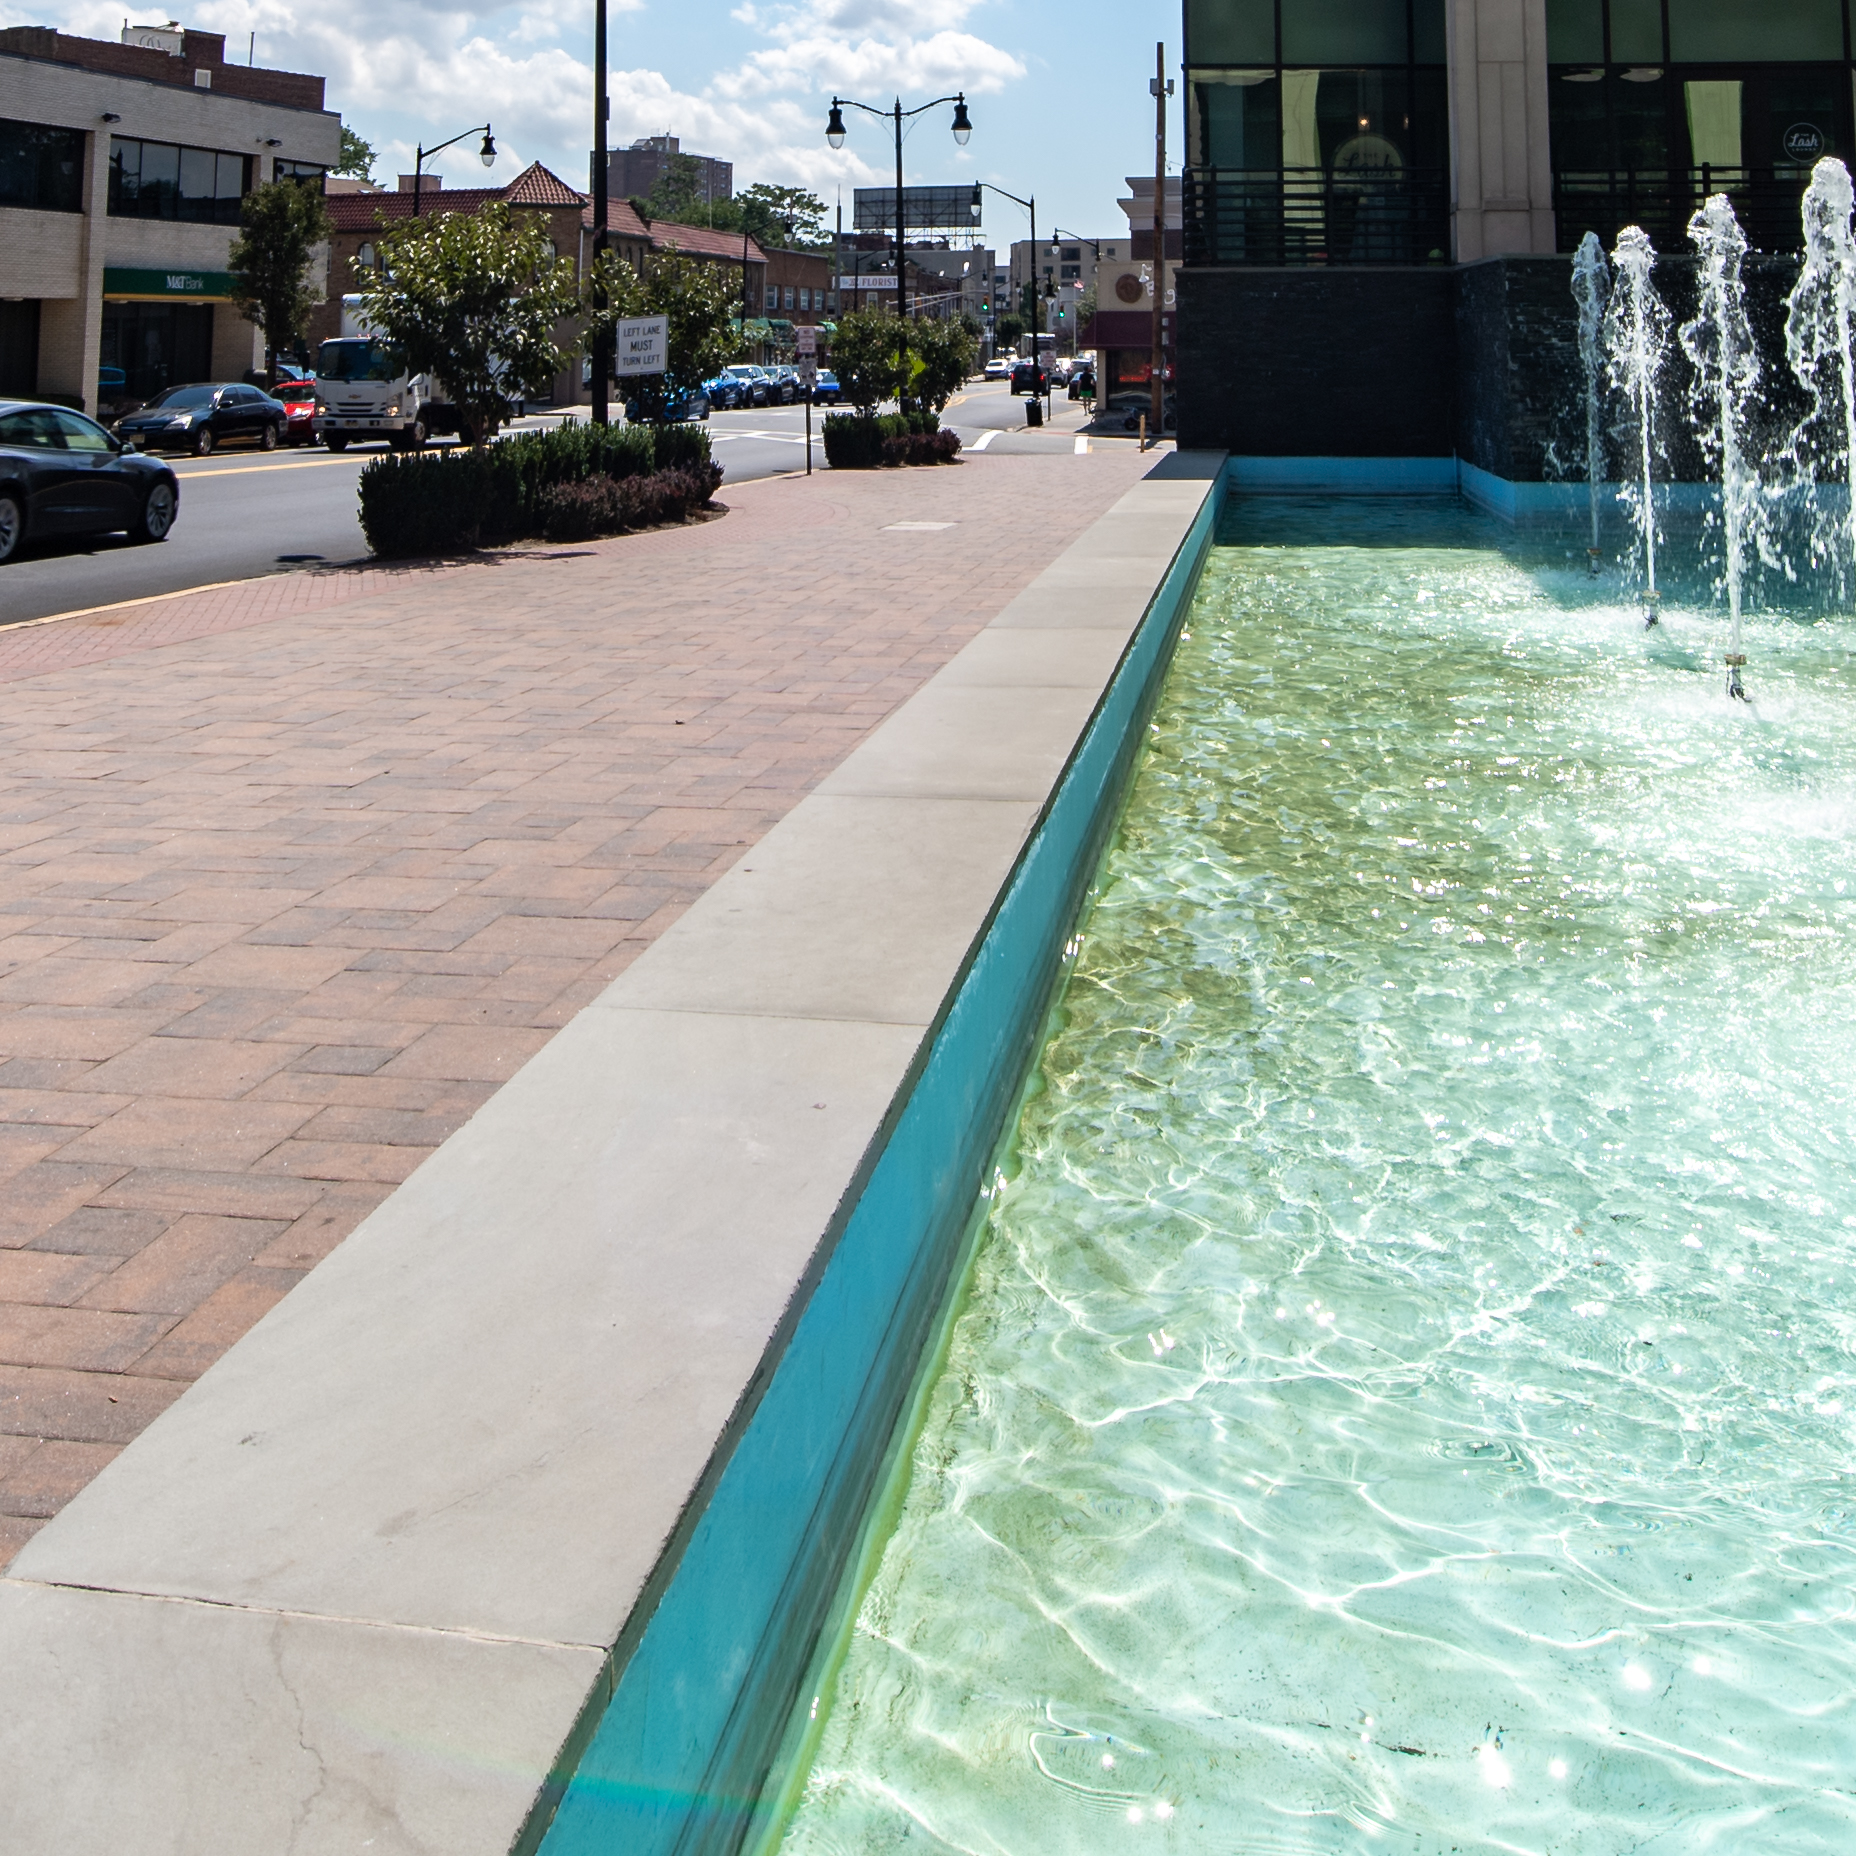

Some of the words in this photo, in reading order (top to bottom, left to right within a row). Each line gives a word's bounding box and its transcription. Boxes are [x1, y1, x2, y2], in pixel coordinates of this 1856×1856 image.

[166, 275, 185, 289] M&T
[185, 276, 204, 290] Bank
[862, 278, 897, 287] FLORIST
[623, 327, 640, 337] LEFT
[642, 325, 661, 336] LANE
[630, 339, 653, 352] MUST
[623, 356, 641, 366] TURN
[643, 354, 660, 365] LEFT
